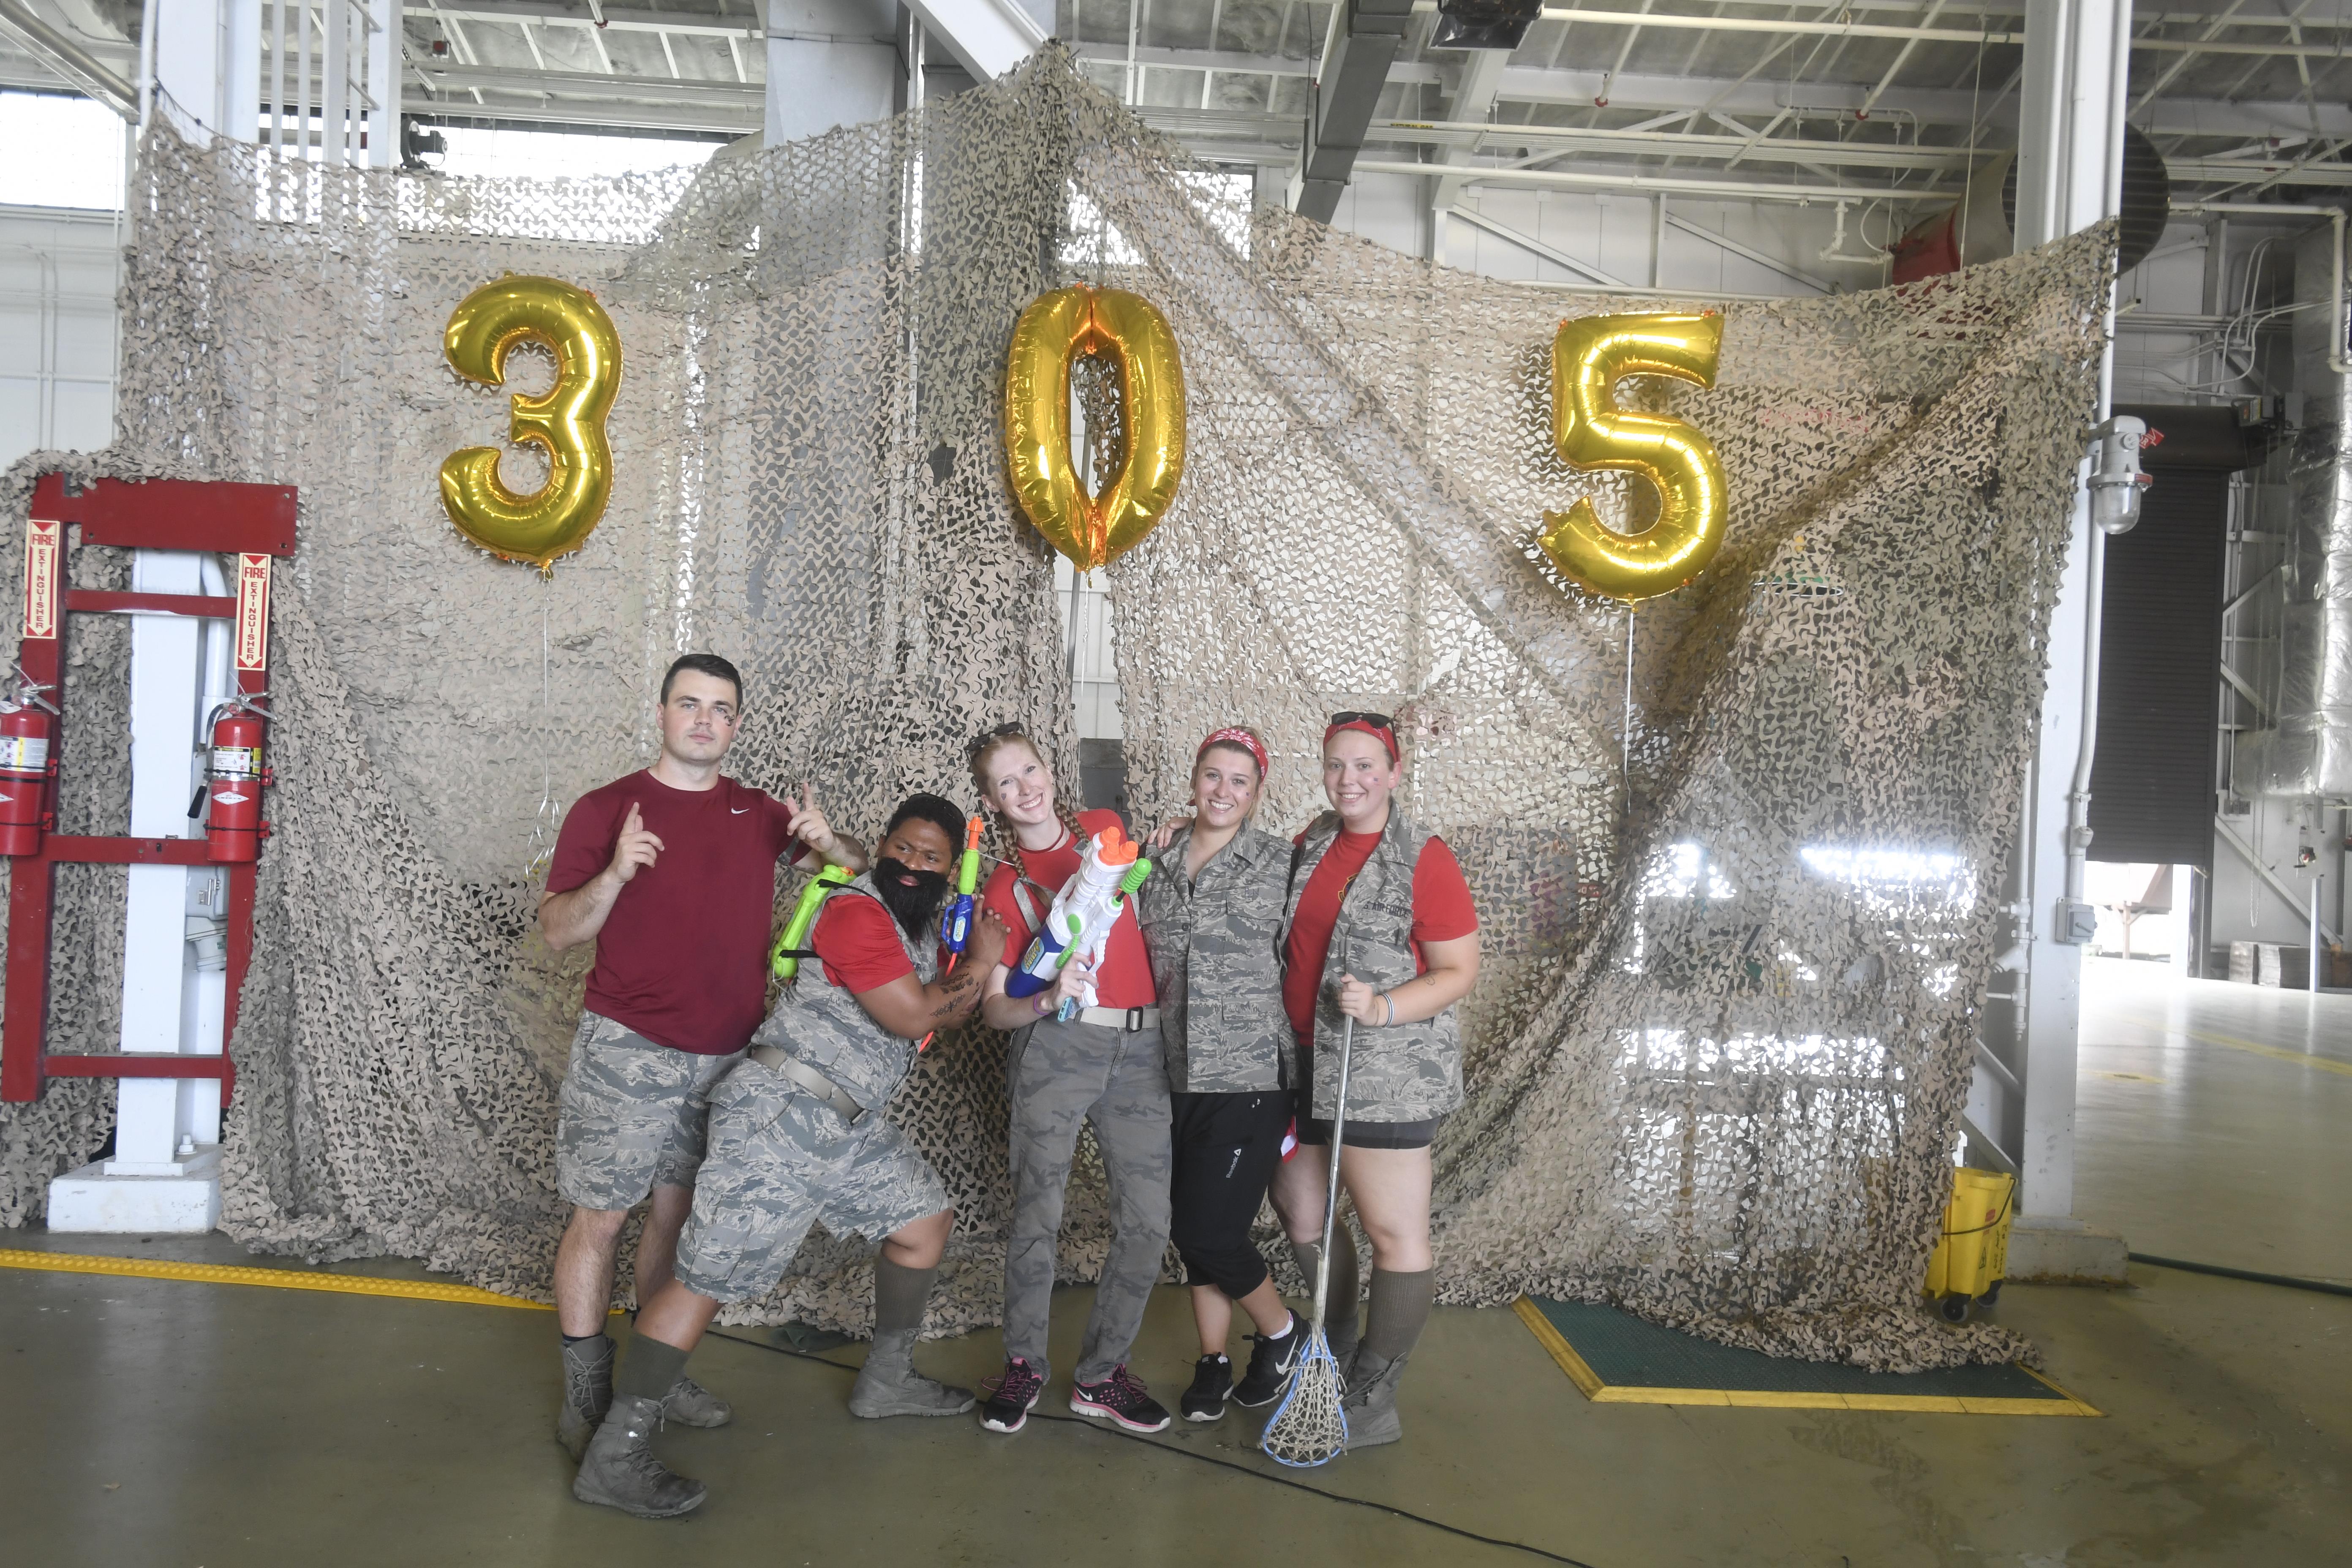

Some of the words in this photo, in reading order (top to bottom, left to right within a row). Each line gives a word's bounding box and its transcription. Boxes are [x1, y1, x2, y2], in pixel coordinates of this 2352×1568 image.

[439, 275, 623, 564] 3
[1005, 284, 1186, 574] 0
[1536, 311, 1728, 602] 5
[32, 534, 54, 546] FIRE
[245, 567, 266, 579] FIRE
[36, 549, 46, 629] EXTINGUISHER
[247, 581, 258, 660] EXTINGUISHER
[1372, 901, 1385, 912] AIR
[1386, 904, 1409, 918] FORCE
[1226, 1156, 1239, 1178] Reebok
